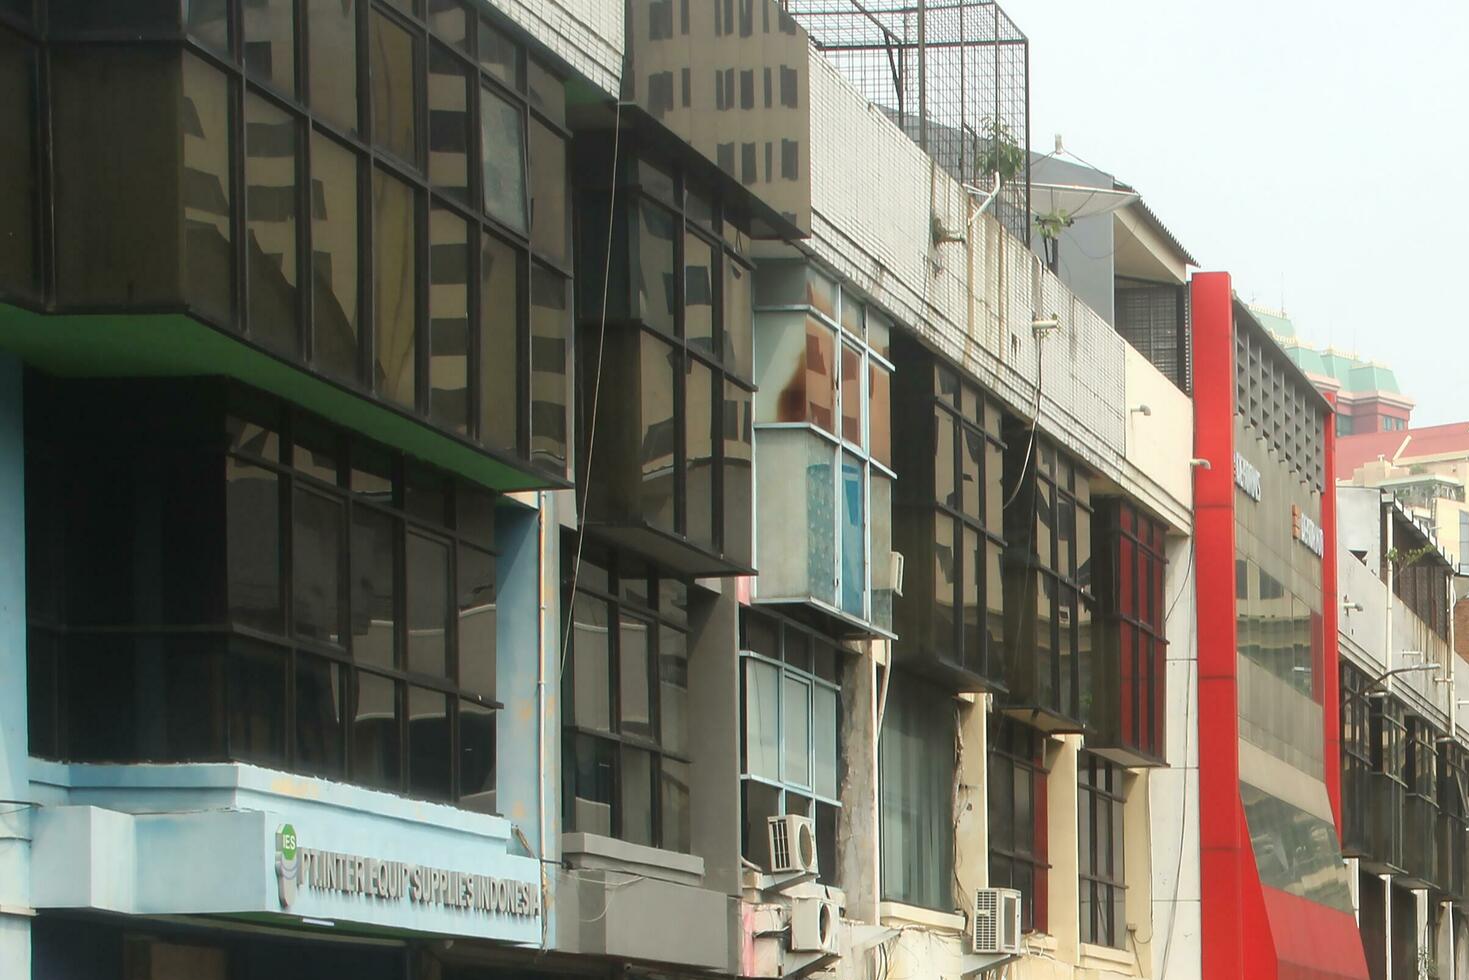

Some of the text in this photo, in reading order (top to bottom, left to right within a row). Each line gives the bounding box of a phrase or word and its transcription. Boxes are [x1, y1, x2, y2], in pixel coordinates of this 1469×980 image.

[283, 834, 296, 850] IES
[366, 858, 409, 899] EQUIP
[410, 864, 474, 908] SUPPLIES
[475, 875, 540, 917] INDONESIA
